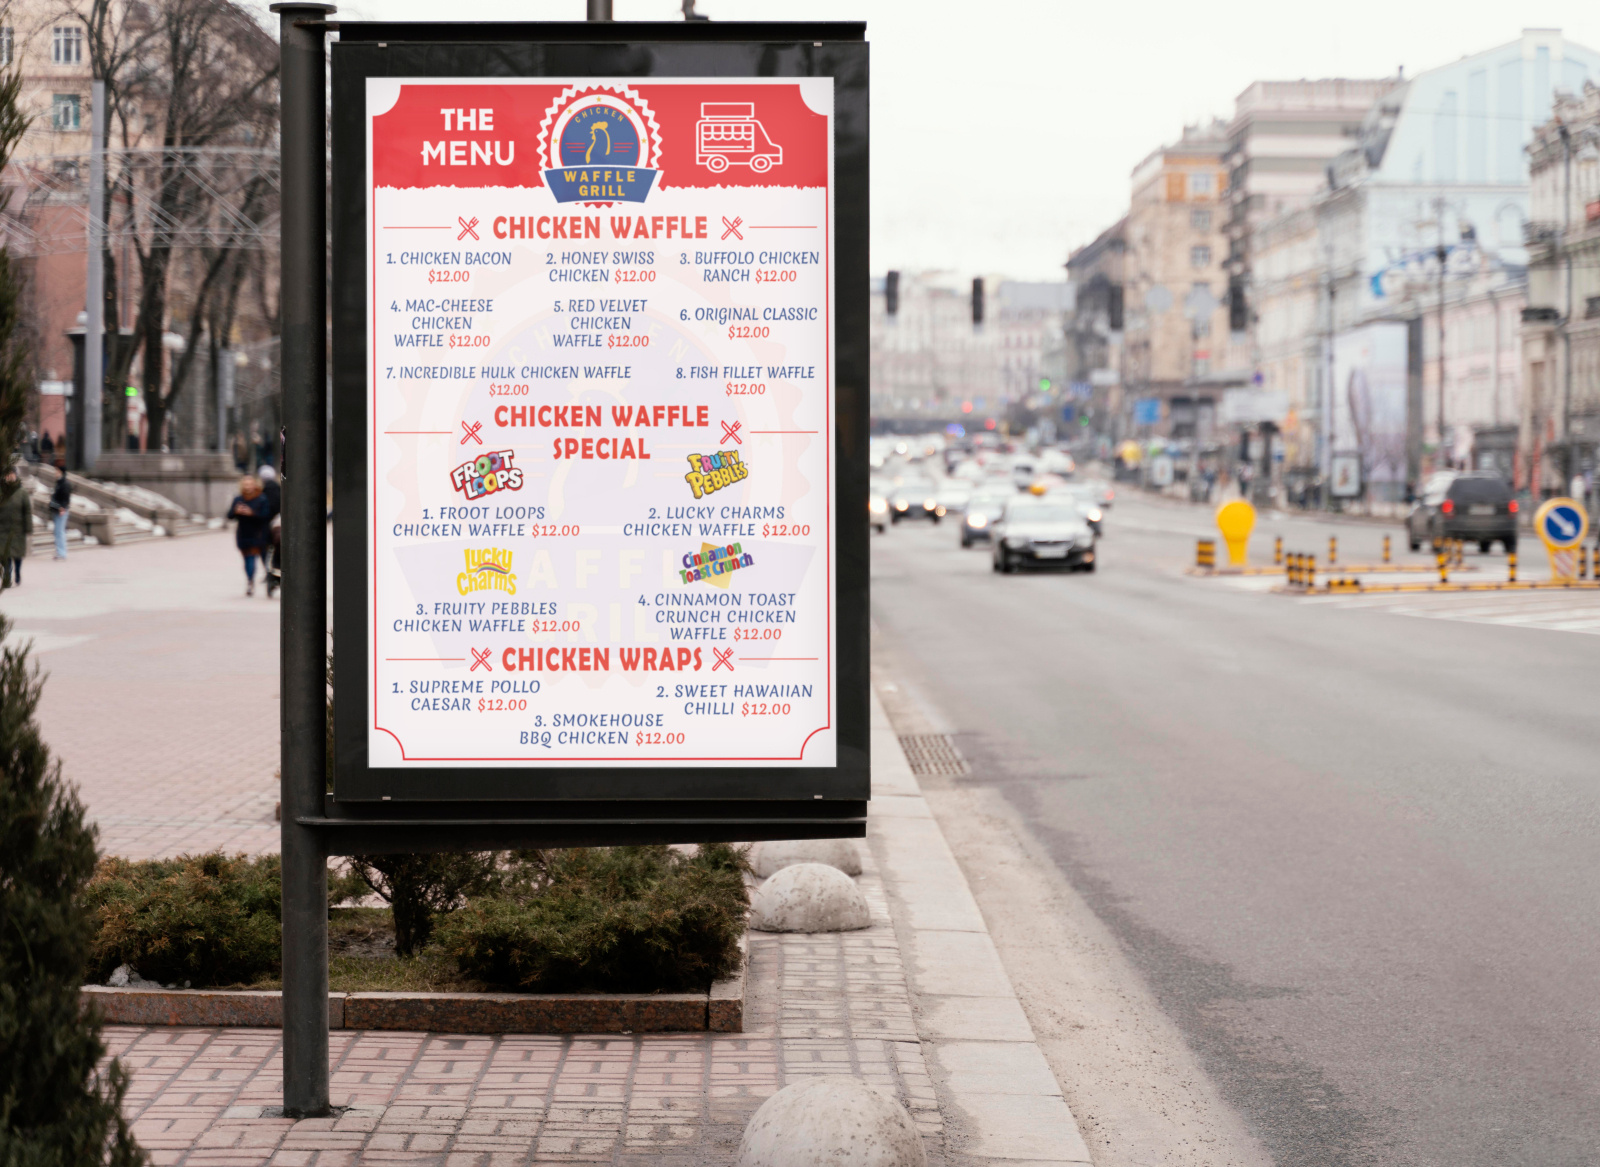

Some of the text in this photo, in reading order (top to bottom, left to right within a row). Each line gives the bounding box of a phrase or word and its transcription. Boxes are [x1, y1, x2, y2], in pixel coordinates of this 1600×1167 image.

[441, 109, 493, 130] THE
[575, 107, 624, 123] CHICKEN
[421, 141, 514, 165] MENU
[564, 171, 635, 182] WAFFLE
[579, 185, 625, 196] GRILL
[493, 216, 707, 239] CHICKEN WAFFLE
[387, 252, 511, 264] 1. CHICKEN BACON
[546, 252, 654, 264] 2. HONEY SWISS
[680, 252, 819, 264] 3. BUFFOLO CHICKEN
[429, 269, 469, 283] $12.00
[550, 269, 656, 283] CHICKEN $12.00
[704, 269, 796, 283] RANCH $12.00
[391, 299, 493, 312] 4. MAC-CHEESE
[554, 300, 647, 312] 5. RED VELVET
[412, 317, 472, 329] CHICKEN
[571, 317, 630, 329] CHICKEN
[680, 308, 817, 325] 6. ORIGINAL CLASSIC
[729, 325, 769, 339] $12.00
[395, 334, 490, 348] WAFFLE $12.00
[553, 335, 649, 349] WAFFLE $12.00
[387, 366, 631, 379] 7. INCREDIBLE HULK CHICKEN WAFFLE
[676, 366, 814, 379] 8. FISH FILLET WAFFLE
[490, 383, 529, 396] $12.00
[726, 382, 765, 396] $12.00
[495, 405, 709, 427] CHICKEN WAFFLE
[553, 438, 650, 459] SPECIAL
[453, 450, 514, 488] FROOT
[465, 469, 522, 499] LOOPS
[685, 462, 748, 499] PEBBLES
[423, 507, 544, 519] 1. FROOT LOOPS
[649, 507, 784, 519] 2. LUCKY CHARMS
[393, 524, 579, 538] CHICKEN WAFFLE $12.00
[624, 524, 810, 538] CHICKEN WAFFLE $12.00
[683, 542, 742, 568] Cinnamon
[679, 553, 754, 584] Toast Crunch
[457, 570, 517, 596] Charms
[639, 593, 795, 606] 4. CINNAMON TOAST
[416, 602, 556, 615] 3. FRUITY PEBBLES
[656, 611, 795, 623] CRUNCH CHICKEN
[394, 619, 580, 633] CHICKEN WAFFLE $12.00
[671, 627, 781, 641] WAFFLE $12.00
[502, 647, 702, 671] CHICKEN WRAPS
[393, 681, 540, 693] 1. SUPREME POLLO
[656, 685, 812, 697] 2. SWEET HAWAIIAN
[412, 698, 526, 712] CAESAR $12.00
[685, 702, 790, 717] CHILLI $12.00
[535, 714, 663, 727] 3. SMOKEHOUSE
[520, 731, 684, 748] BBQ CHICKEN $12.00
